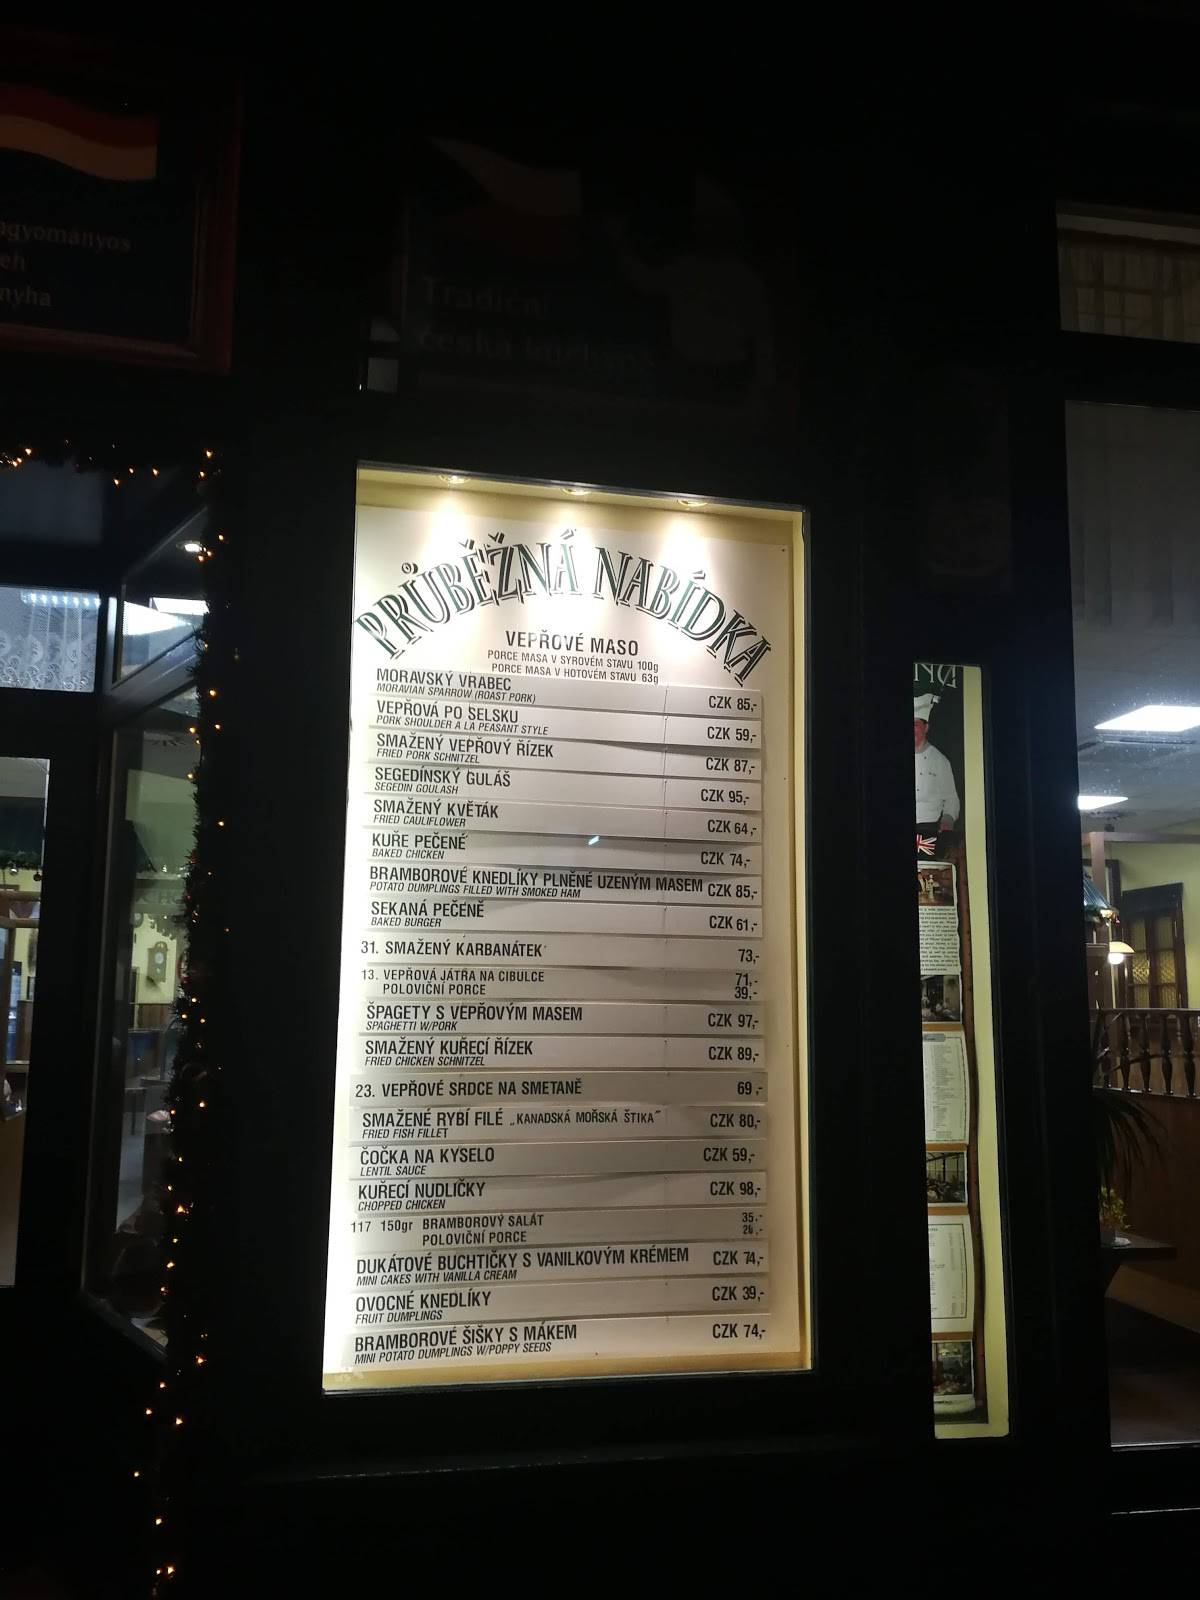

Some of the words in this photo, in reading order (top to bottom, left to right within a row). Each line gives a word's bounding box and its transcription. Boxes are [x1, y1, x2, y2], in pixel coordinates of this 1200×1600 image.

[354, 527, 581, 660] PRŮBĚŽNÁ
[593, 546, 771, 688] NABÍDKA
[506, 630, 584, 652] VEPŘOVÉ
[591, 638, 638, 656] MASO
[488, 650, 518, 661] PORCE
[522, 652, 547, 663] MASA
[561, 655, 603, 667] SYROVÉM
[607, 660, 632, 669] STAVU
[638, 662, 659, 673] 100g
[377, 668, 453, 687] MORAVSKÝ
[459, 674, 511, 691] VRABEC
[492, 663, 522, 674] PORCE
[525, 666, 551, 676] MASA
[564, 669, 607, 680] HOTOVÉM
[610, 672, 636, 682] STAVU
[642, 674, 659, 684] 63g
[377, 683, 424, 695] MORAVIAN
[428, 687, 473, 699] SPARROW
[474, 690, 506, 701] (ROAST
[509, 693, 536, 704] PORK)
[377, 699, 439, 718] VEPŘOVÁ
[445, 706, 463, 719] PO
[468, 707, 518, 723] SELSKU
[709, 696, 732, 709] CZK
[737, 698, 757, 712] 85,-
[377, 715, 401, 725] PORK
[404, 717, 451, 729] SHOULDER
[479, 723, 518, 734] PEASANT
[521, 726, 549, 736] STYLE
[377, 733, 444, 750] SMAŽENÝ
[449, 737, 512, 755] VEPŘOVÝ
[517, 739, 554, 758] ŘÍZEK
[377, 749, 402, 758] FRIED
[406, 751, 430, 761] PORK
[434, 752, 480, 764] SCHNITZEL
[706, 757, 729, 772] CZK
[734, 759, 755, 774] 87,-
[375, 765, 461, 784] SEGEDÍNSKÝ
[467, 770, 511, 788] GULÁŠ
[375, 782, 412, 792] SEGEDIN
[416, 784, 458, 795] GOULASH
[374, 797, 441, 815] SMAŽENÝ
[448, 800, 498, 818] KVĚTÁK
[373, 815, 400, 824] FRIED
[403, 816, 466, 827] CAULIFLOWER
[372, 831, 408, 847] KUŘE
[415, 832, 466, 850] PEČENÉ
[372, 848, 402, 857] BAKED
[406, 849, 445, 859] CHICKEN
[701, 852, 724, 865] CZK
[730, 853, 750, 868] 74,-
[370, 866, 467, 883] BRAMBOROVÉ
[473, 868, 538, 886] KNEDLÍKY
[544, 872, 592, 888] PLNĚNÉ
[598, 874, 650, 890] UZENÝM
[656, 877, 703, 892] MASEM
[370, 881, 404, 891] POTATO
[408, 883, 460, 894] DUMPLINGS
[463, 885, 492, 895] FILLED
[496, 886, 518, 896] WITH
[521, 887, 557, 897] SMOKED
[560, 888, 581, 899] HAM
[371, 899, 428, 916] SEKANÁ
[371, 917, 401, 926] BAKED
[404, 917, 441, 927] BURGER
[361, 941, 379, 954] 31.
[385, 938, 450, 955] SMAŽENÝ
[456, 941, 542, 957] KARBANÁTEK
[361, 970, 378, 980] 13.
[384, 967, 436, 981] VEPŘOVÁ
[441, 968, 476, 981] JÁTRA
[480, 971, 494, 981] NA
[499, 971, 544, 981] CIBULCE
[383, 981, 445, 995] POLOVIČNÍ
[449, 984, 485, 995] PORCE
[367, 1002, 430, 1020] ŠPAGETY
[451, 1002, 527, 1020] VEPŘOVÝM
[532, 1006, 583, 1020] MASEM
[366, 1021, 416, 1030] SPAGHETTI
[420, 1021, 458, 1031] W/PORK
[365, 1037, 435, 1055] SMAŽENÝ
[440, 1037, 489, 1055] KUŘECÍ
[494, 1037, 533, 1055] ŘÍZEK
[365, 1056, 392, 1066] FRIED
[396, 1057, 434, 1066] CHICKEN
[438, 1057, 485, 1066] SCHNITZEL
[355, 1085, 375, 1098] 23.
[382, 1080, 444, 1097] VEPŘOVÉ
[449, 1081, 493, 1096] SRDCE
[498, 1081, 516, 1095] NA
[522, 1078, 582, 1095] SMETANĚ
[363, 1109, 431, 1127] SMAŽENÉ
[437, 1108, 469, 1126] RYBÍ
[475, 1108, 503, 1126] FILÉ
[576, 1109, 618, 1123] MOŘSKÁ
[710, 1113, 734, 1128] CZK
[739, 1114, 761, 1129] 80,-
[363, 1129, 390, 1139] FRIED
[393, 1128, 414, 1138] FISH
[418, 1128, 448, 1138] FILLET
[360, 1147, 409, 1165] ČOČKA
[415, 1149, 434, 1164] NA
[440, 1148, 495, 1163] KYSELO
[360, 1166, 392, 1177] LENTIL
[396, 1165, 426, 1175] SAUCE
[358, 1180, 409, 1199] KUŘECÍ
[415, 1178, 485, 1198] NUDLIČKY
[710, 1181, 735, 1196] CZK
[740, 1181, 761, 1197] 98,-
[358, 1201, 402, 1211] CHOPPED
[405, 1200, 446, 1210] CHICKEN
[351, 1221, 371, 1233] 117
[381, 1220, 413, 1234] 150gr
[423, 1215, 504, 1230] BRAMBOROVÝ
[508, 1214, 544, 1227] SALÁT
[423, 1231, 485, 1246] POLOVIČNÍ
[489, 1232, 527, 1243] PORCE
[357, 1253, 432, 1273] DUKÁTOVÉ
[438, 1250, 517, 1270] BUCHTIČKY
[537, 1247, 625, 1266] VANILKOVÝM
[630, 1245, 689, 1263] KRÉMEM
[356, 1276, 377, 1286] MINI
[381, 1274, 411, 1284] CAKES
[415, 1273, 439, 1283] WITH
[443, 1271, 480, 1282] VANILLA
[483, 1270, 517, 1280] CREAM
[356, 1292, 414, 1312] OVOCNÉ
[420, 1289, 491, 1309] KNEDLÍKY
[712, 1286, 737, 1301] CZK
[743, 1286, 765, 1301] 39,-
[356, 1313, 384, 1324] FRUIT
[387, 1310, 443, 1322] DUMPLINGS
[355, 1327, 457, 1351] BRAMBOROVÉ
[463, 1323, 504, 1343] ŠIŠKY
[524, 1321, 577, 1340] MÁKEM
[355, 1354, 376, 1364] MINI
[380, 1351, 415, 1362] POTATO
[418, 1346, 473, 1360] DUMPLINGS
[476, 1344, 519, 1355] W/POPPY
[523, 1342, 552, 1352] SEEDS
